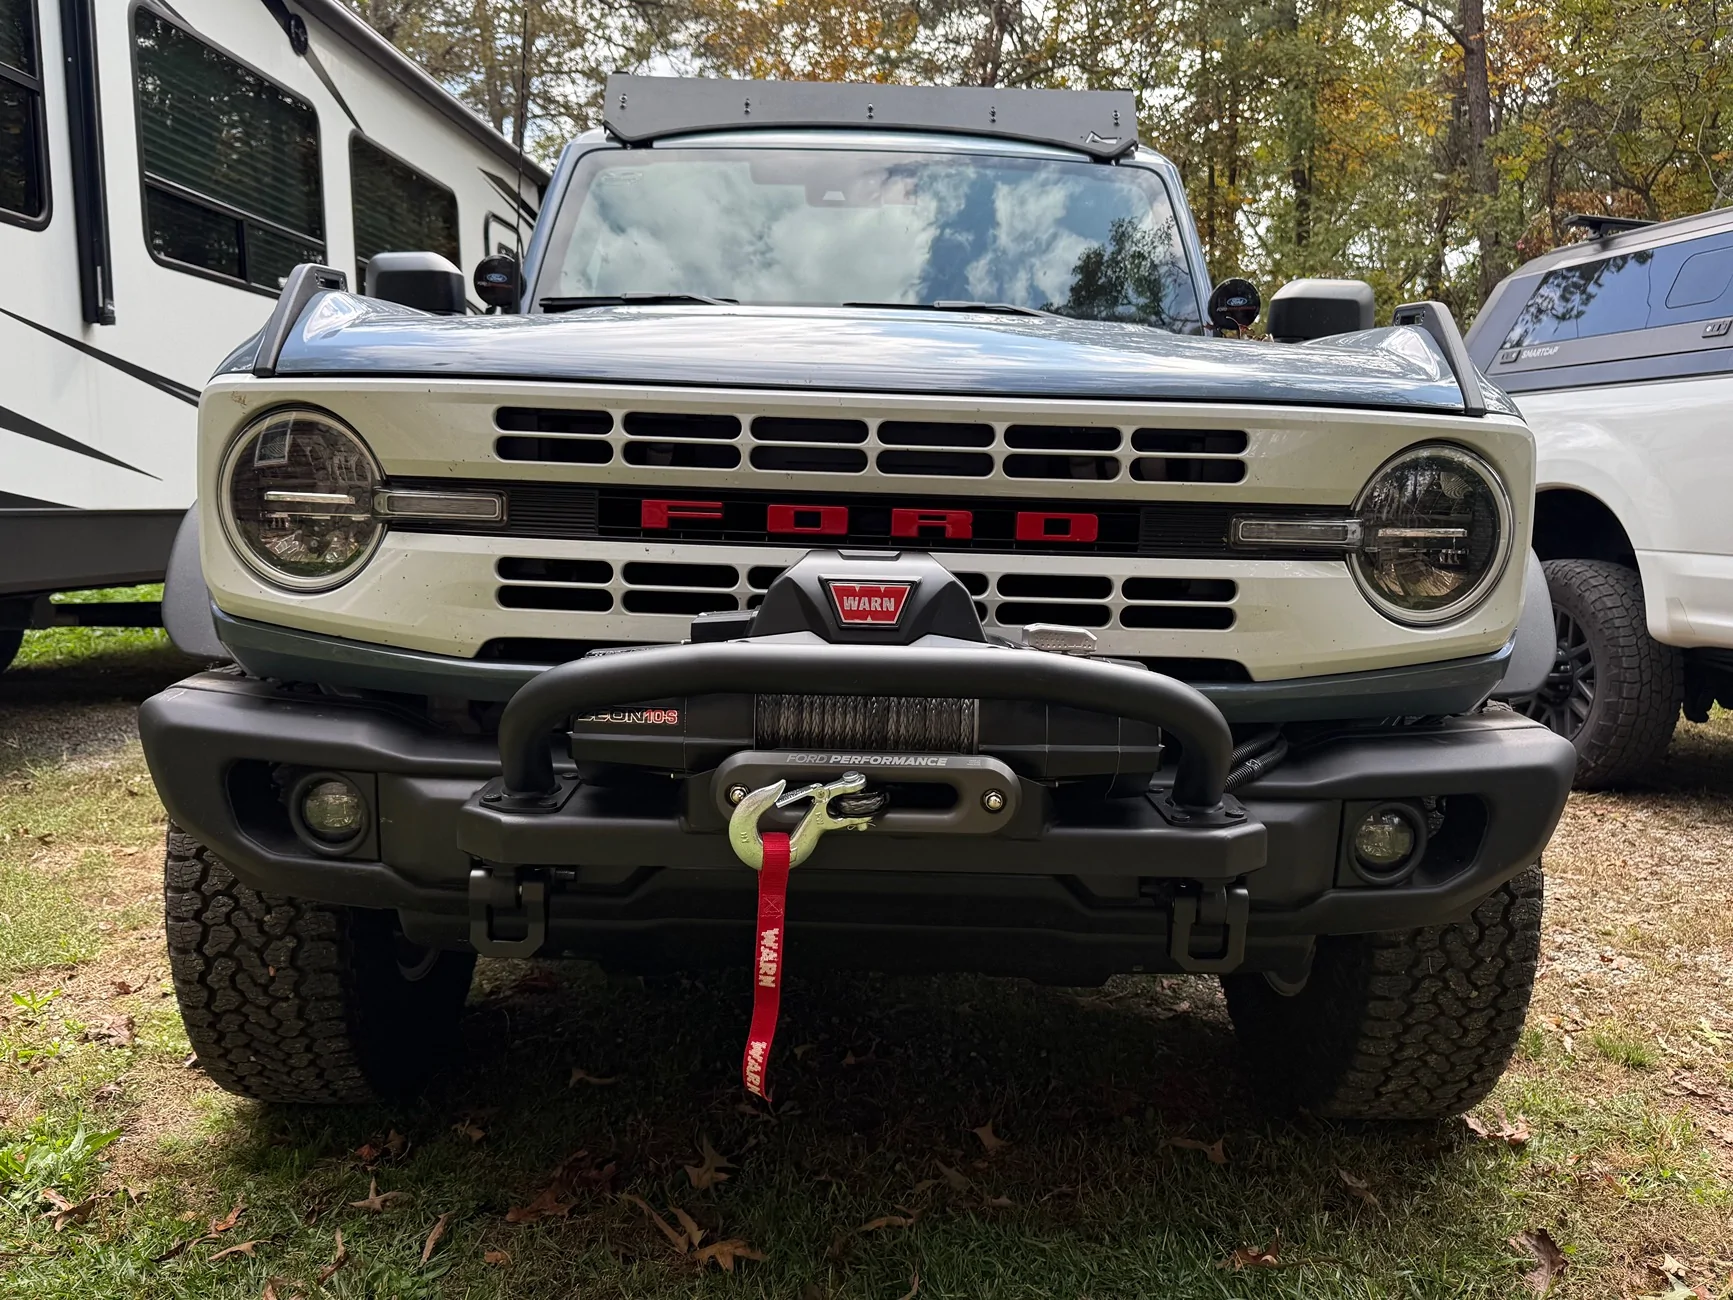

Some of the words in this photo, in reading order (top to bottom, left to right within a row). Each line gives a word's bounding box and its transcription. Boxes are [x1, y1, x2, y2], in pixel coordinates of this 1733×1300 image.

[1521, 346, 1559, 359] SMARTCAP
[641, 499, 1099, 543] FORD
[843, 596, 895, 612] WARN
[786, 753, 828, 764] FORD
[828, 755, 948, 766] PERFORMANCE
[759, 927, 780, 988] WARN
